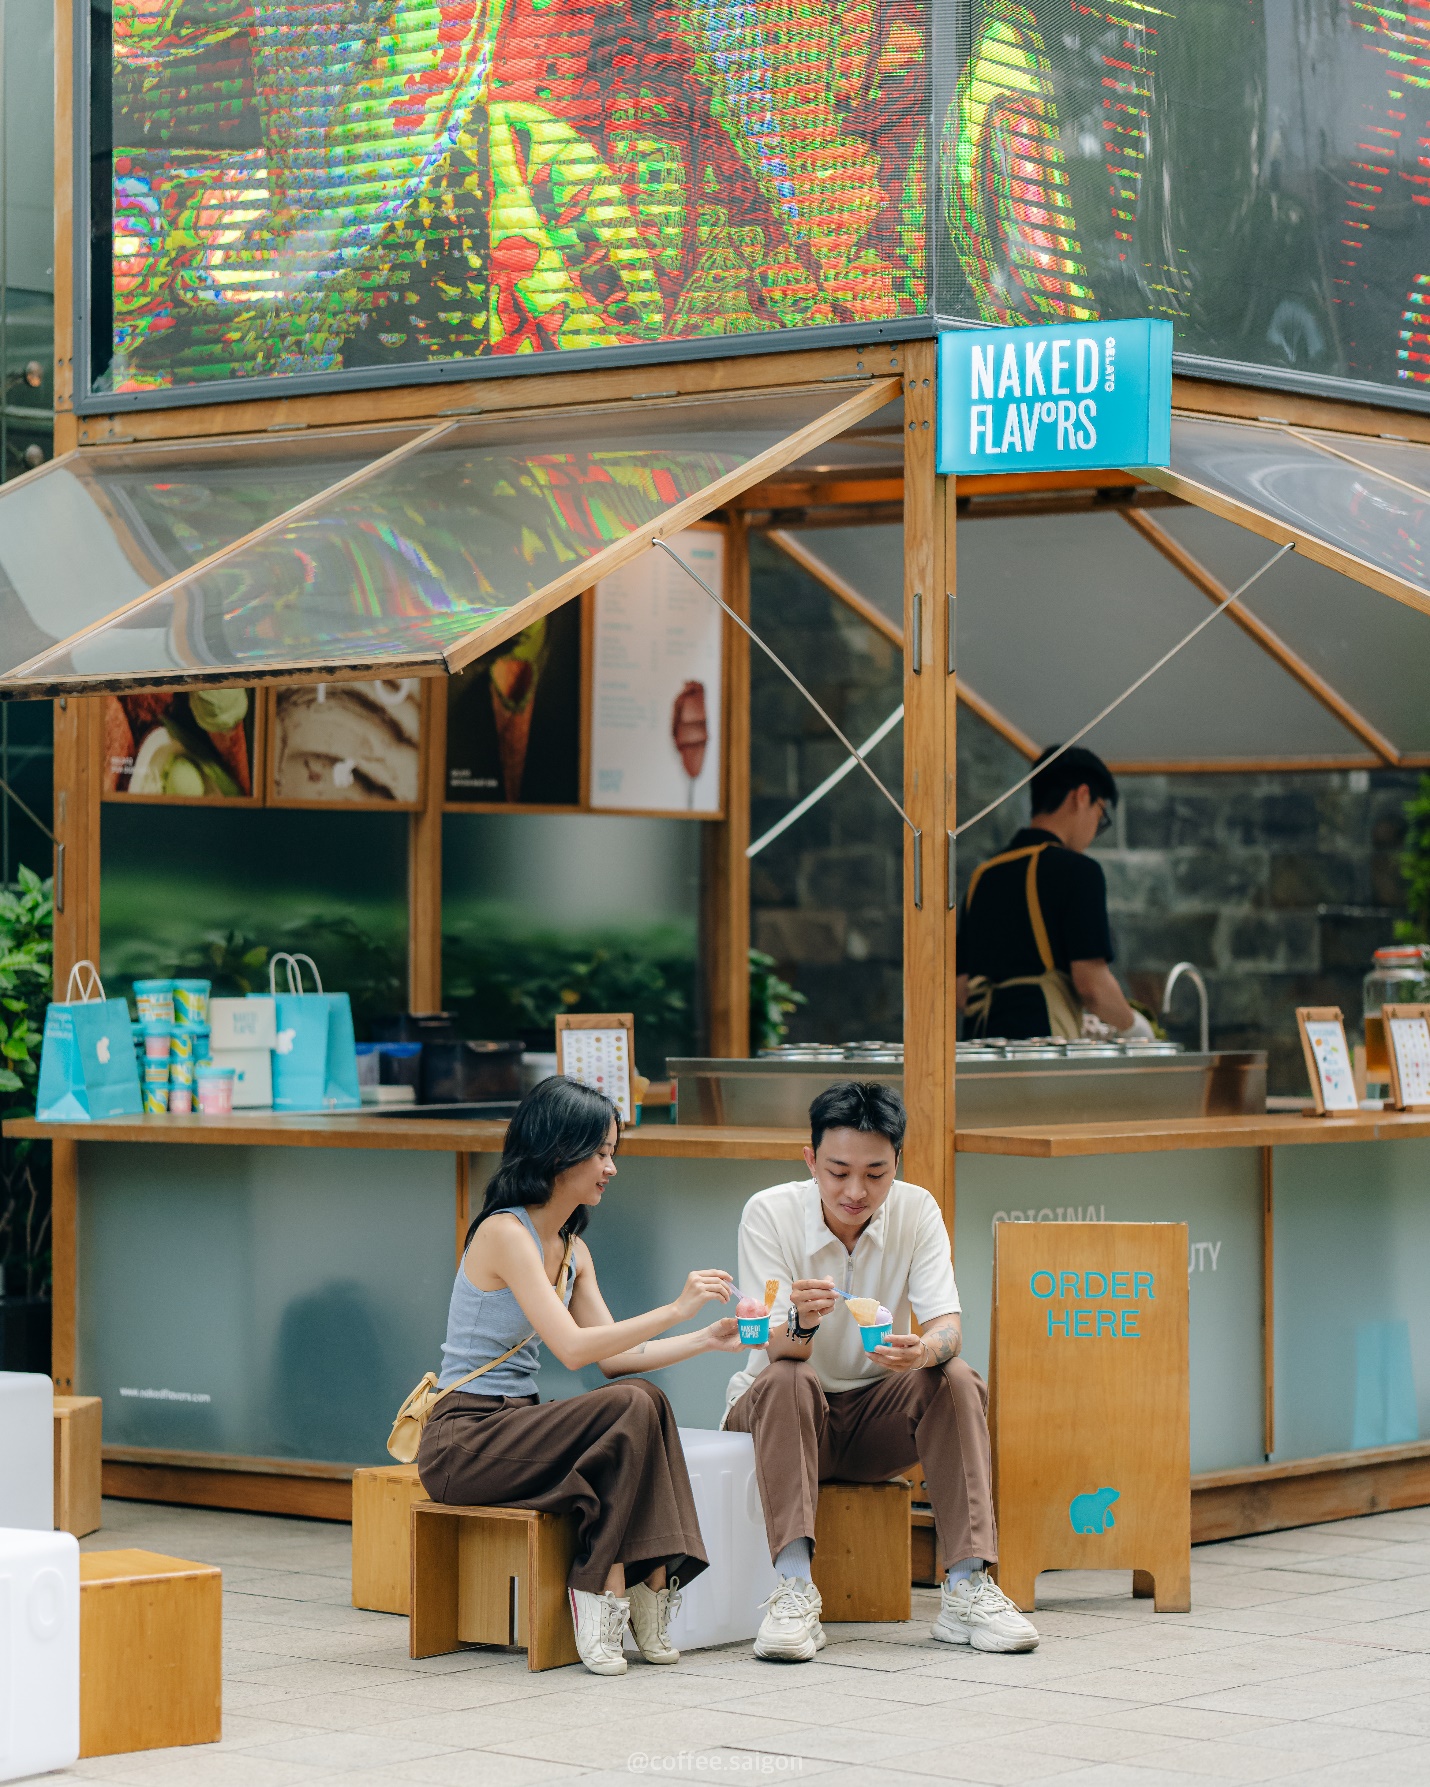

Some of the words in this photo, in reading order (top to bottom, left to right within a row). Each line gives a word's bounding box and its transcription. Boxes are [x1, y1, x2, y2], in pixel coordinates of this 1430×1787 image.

[971, 338, 1099, 400] NAKED
[1104, 336, 1116, 392] GELATO
[970, 399, 1097, 454] FLAVORS
[1030, 1270, 1156, 1299] ORDER
[1047, 1309, 1141, 1338] HERE
